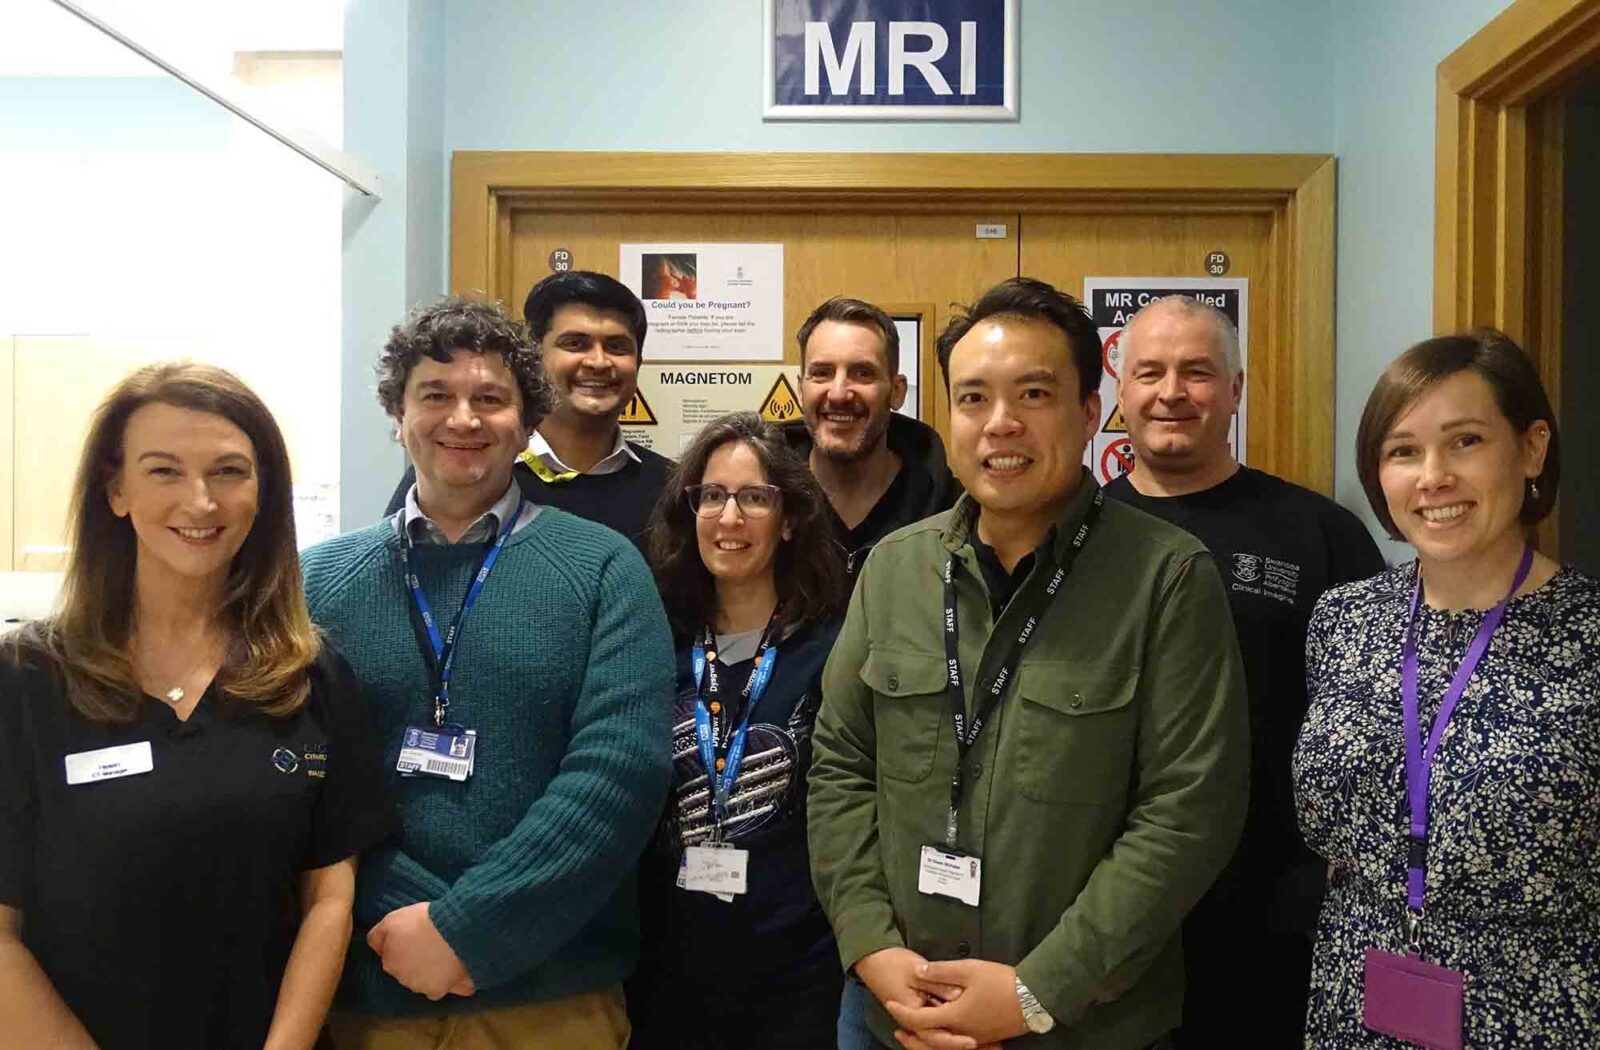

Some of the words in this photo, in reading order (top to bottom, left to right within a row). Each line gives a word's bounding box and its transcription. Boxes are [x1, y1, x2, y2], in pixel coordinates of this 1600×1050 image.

[804, 21, 977, 95] MRI
[555, 251, 569, 260] FD
[555, 262, 568, 271] 30
[1210, 254, 1225, 263] FD
[1210, 264, 1224, 274] 30
[651, 301, 677, 309] Could
[678, 302, 694, 311] you
[695, 301, 706, 309] be
[708, 301, 752, 311] Pregnant?
[1105, 292, 1133, 307] MR
[1138, 292, 1226, 308] Colled
[660, 372, 752, 385] MAGNETOM
[1073, 523, 1089, 547] STAFF
[1046, 567, 1066, 595] STAFF
[1231, 583, 1262, 594] Clinical
[945, 608, 954, 633] STAFF
[1018, 616, 1037, 644] STAFF
[949, 659, 960, 687] STAFF
[991, 666, 1010, 695] STAFF
[955, 713, 964, 742] STAFF
[966, 718, 983, 746] STAFF
